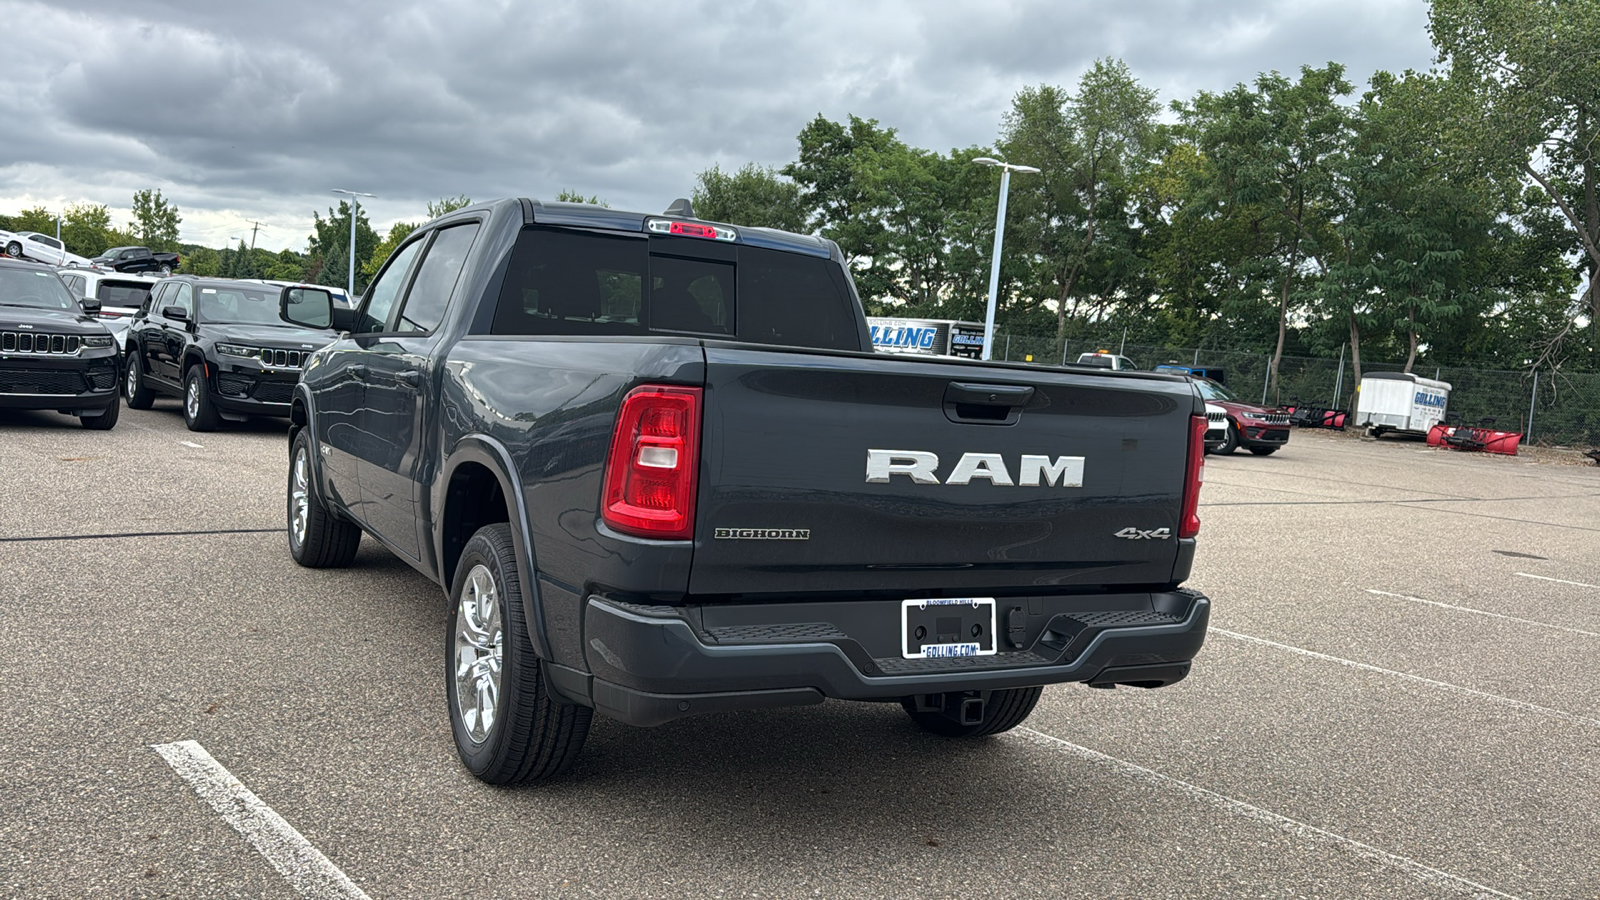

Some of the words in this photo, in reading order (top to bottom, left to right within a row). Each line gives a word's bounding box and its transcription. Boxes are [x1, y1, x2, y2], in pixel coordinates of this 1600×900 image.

[870, 325, 937, 349] LLING
[952, 334, 985, 345] GOLLIN
[1414, 391, 1446, 409] GOLLING
[865, 449, 1085, 488] RAM
[714, 527, 810, 540] BIGHORN
[1112, 527, 1171, 540] 4x4
[926, 644, 977, 658] GOLLING.COM
